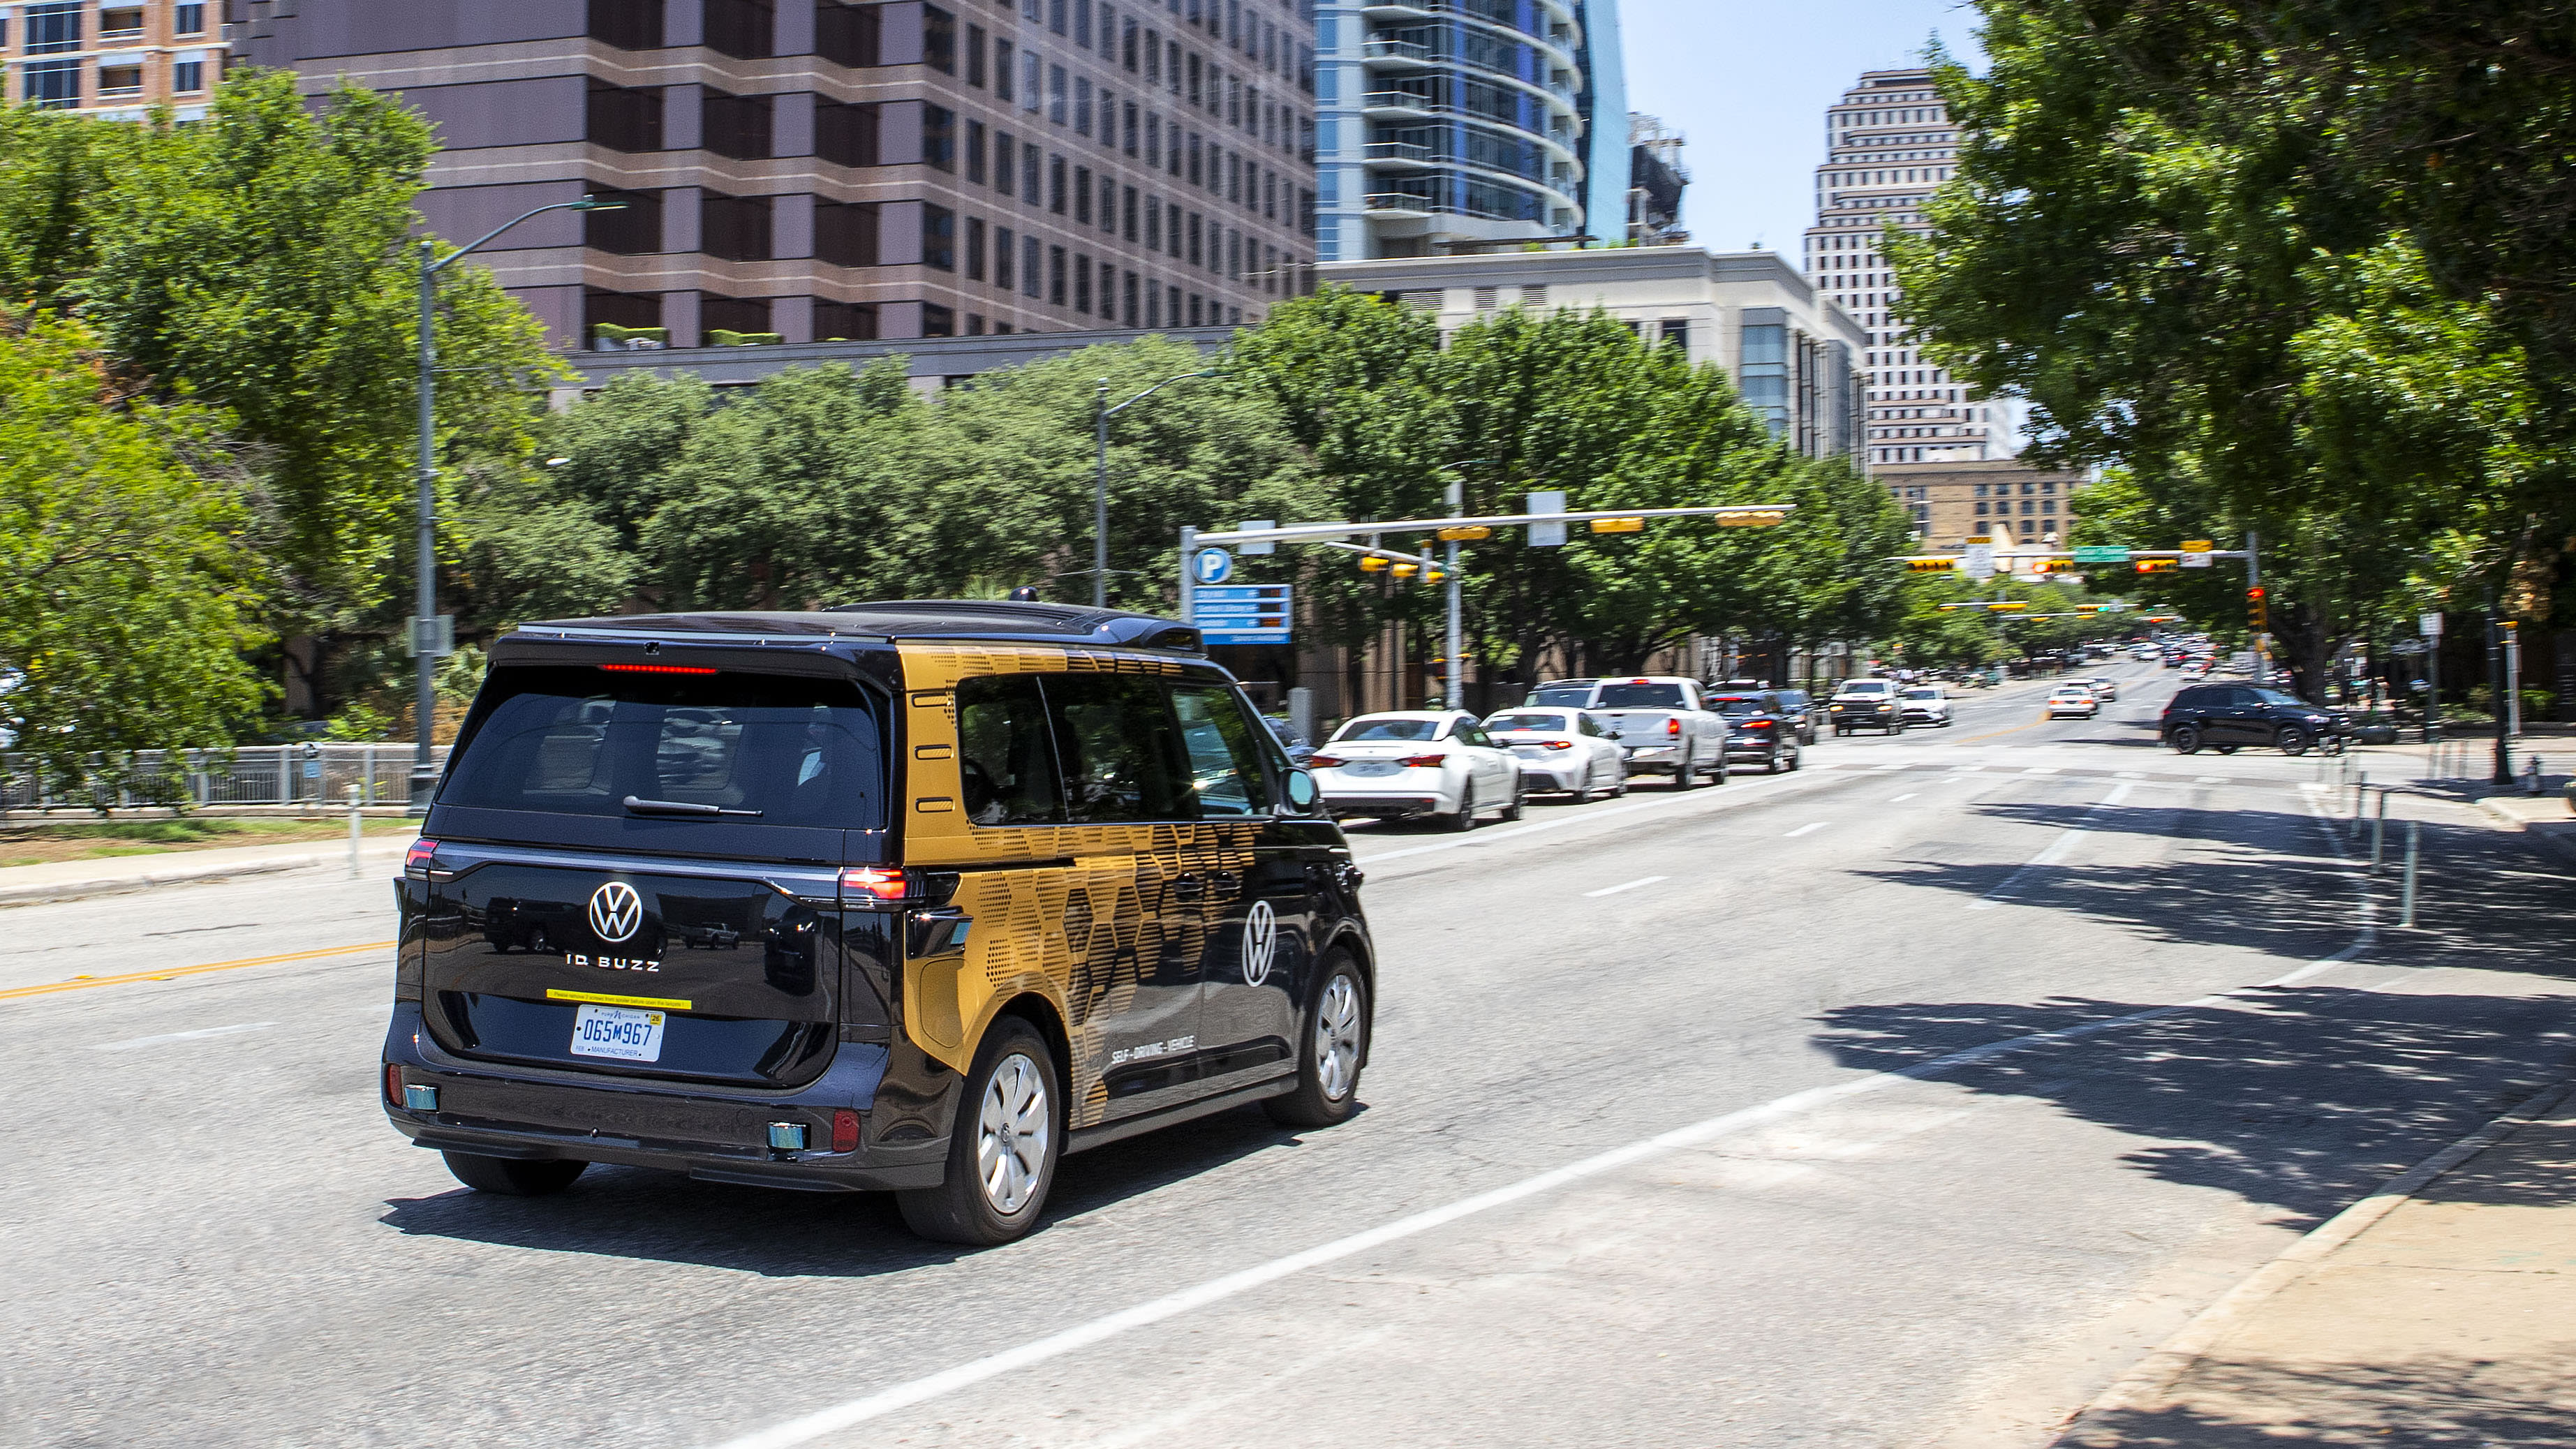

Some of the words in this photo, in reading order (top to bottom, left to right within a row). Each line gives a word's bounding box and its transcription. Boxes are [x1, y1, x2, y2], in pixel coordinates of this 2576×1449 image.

[1201, 554, 1222, 579] P
[598, 956, 660, 972] BUZZ
[584, 1019, 652, 1046] 065M967
[591, 1046, 638, 1056] MANUFACTURER
